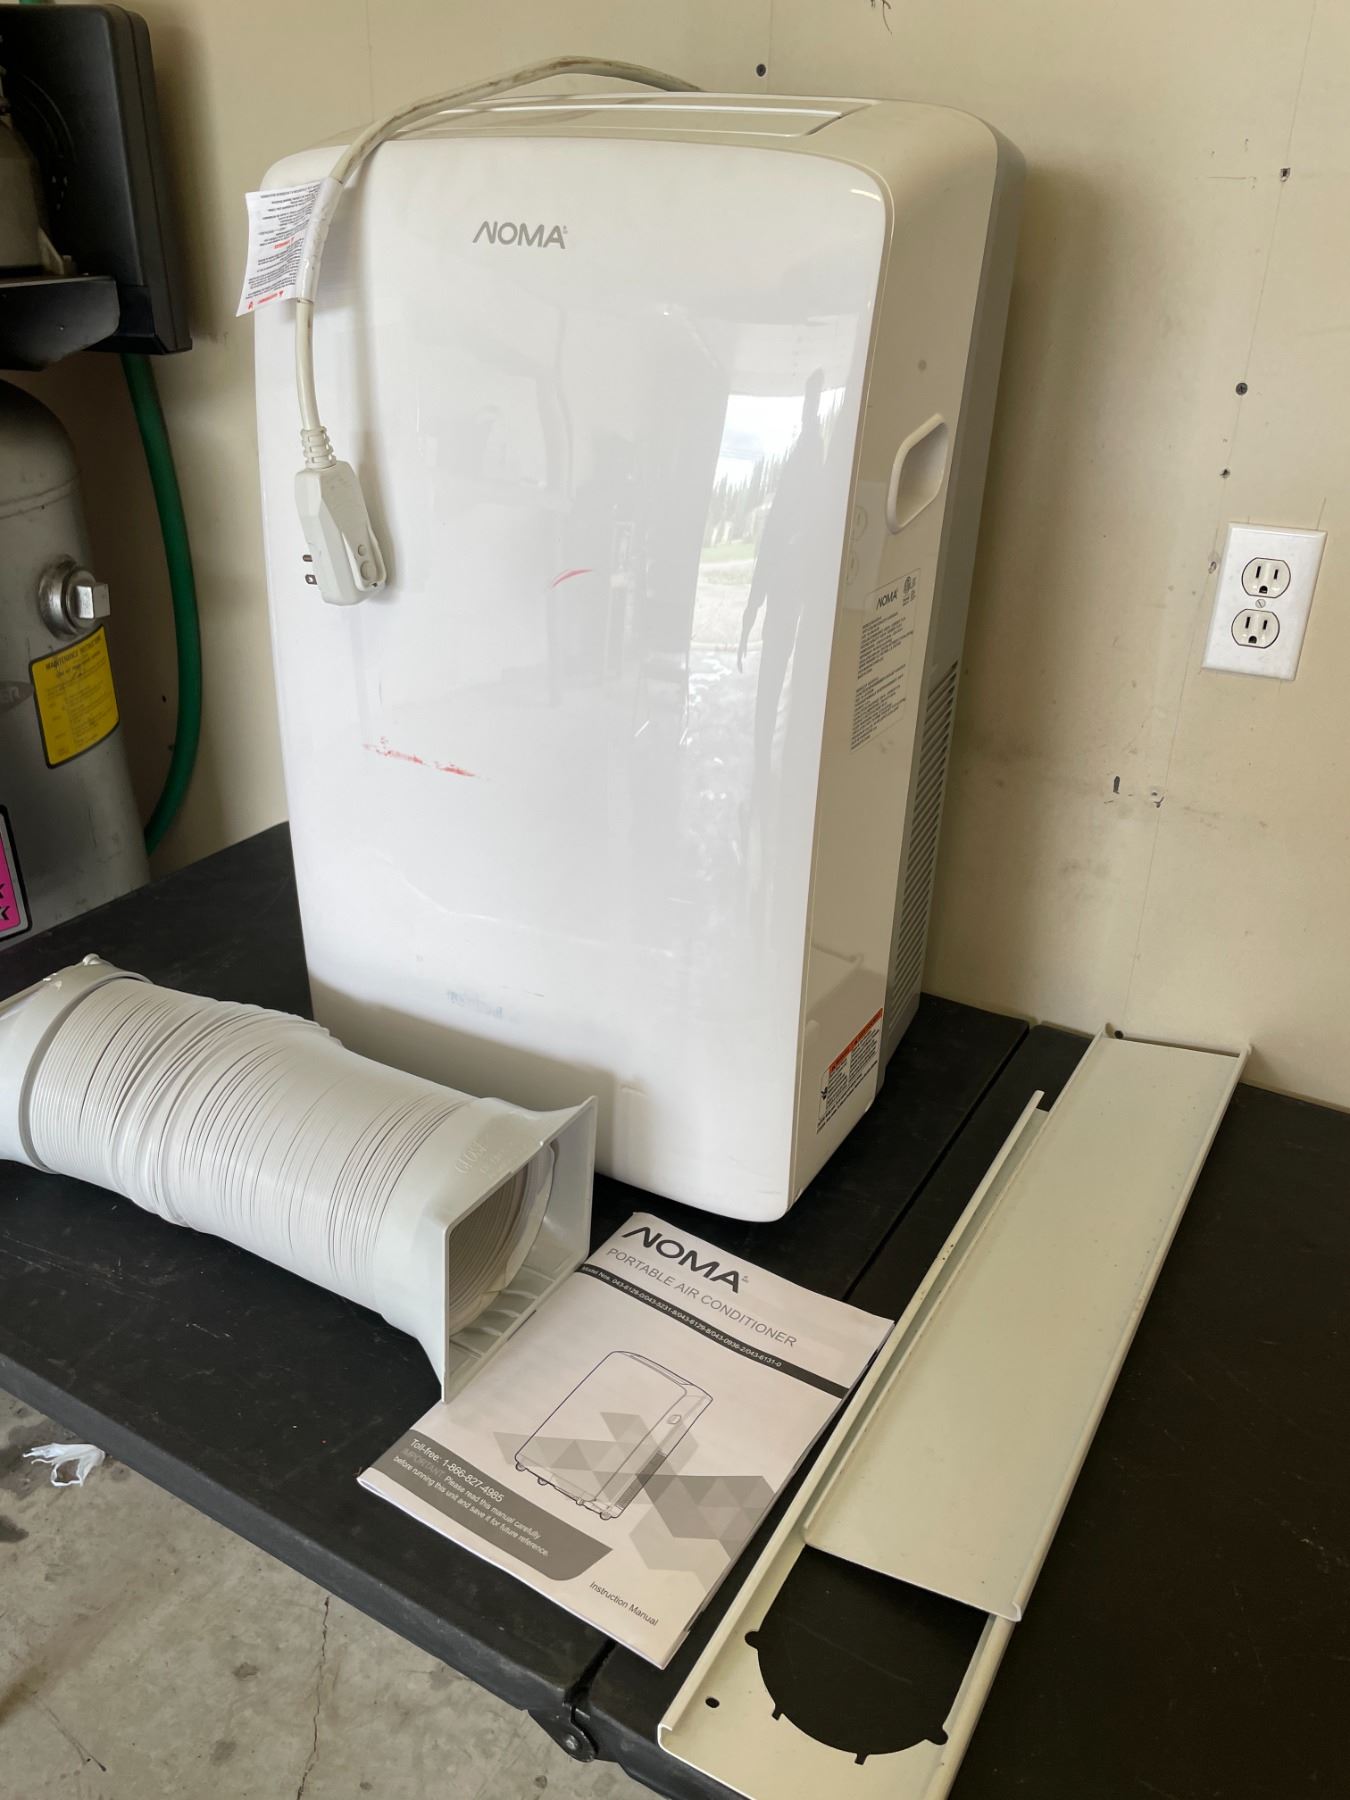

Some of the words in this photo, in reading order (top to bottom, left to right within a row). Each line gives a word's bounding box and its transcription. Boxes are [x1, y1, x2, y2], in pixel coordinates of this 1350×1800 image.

[472, 220, 566, 249] NOMA
[876, 590, 898, 610] NOMA
[621, 1226, 740, 1293] NOMA
[607, 1248, 675, 1287] PORTABLE
[677, 1282, 700, 1299] AIR
[701, 1295, 798, 1347] CONDITIONER
[393, 1455, 413, 1471] before
[412, 1467, 435, 1486] running
[434, 1482, 446, 1493] this
[446, 1490, 459, 1501] unit
[457, 1499, 471, 1509] and
[470, 1506, 486, 1518] save
[490, 1517, 500, 1526] for
[500, 1523, 518, 1538] future
[410, 1438, 441, 1463] Toll-free:
[442, 1459, 504, 1502] 1-866-827-4985
[444, 1476, 465, 1492] Please
[465, 1490, 480, 1502] read
[480, 1499, 491, 1509] this
[490, 1507, 515, 1523] manual
[590, 1581, 628, 1608] Instruction
[629, 1604, 659, 1626] Manual
